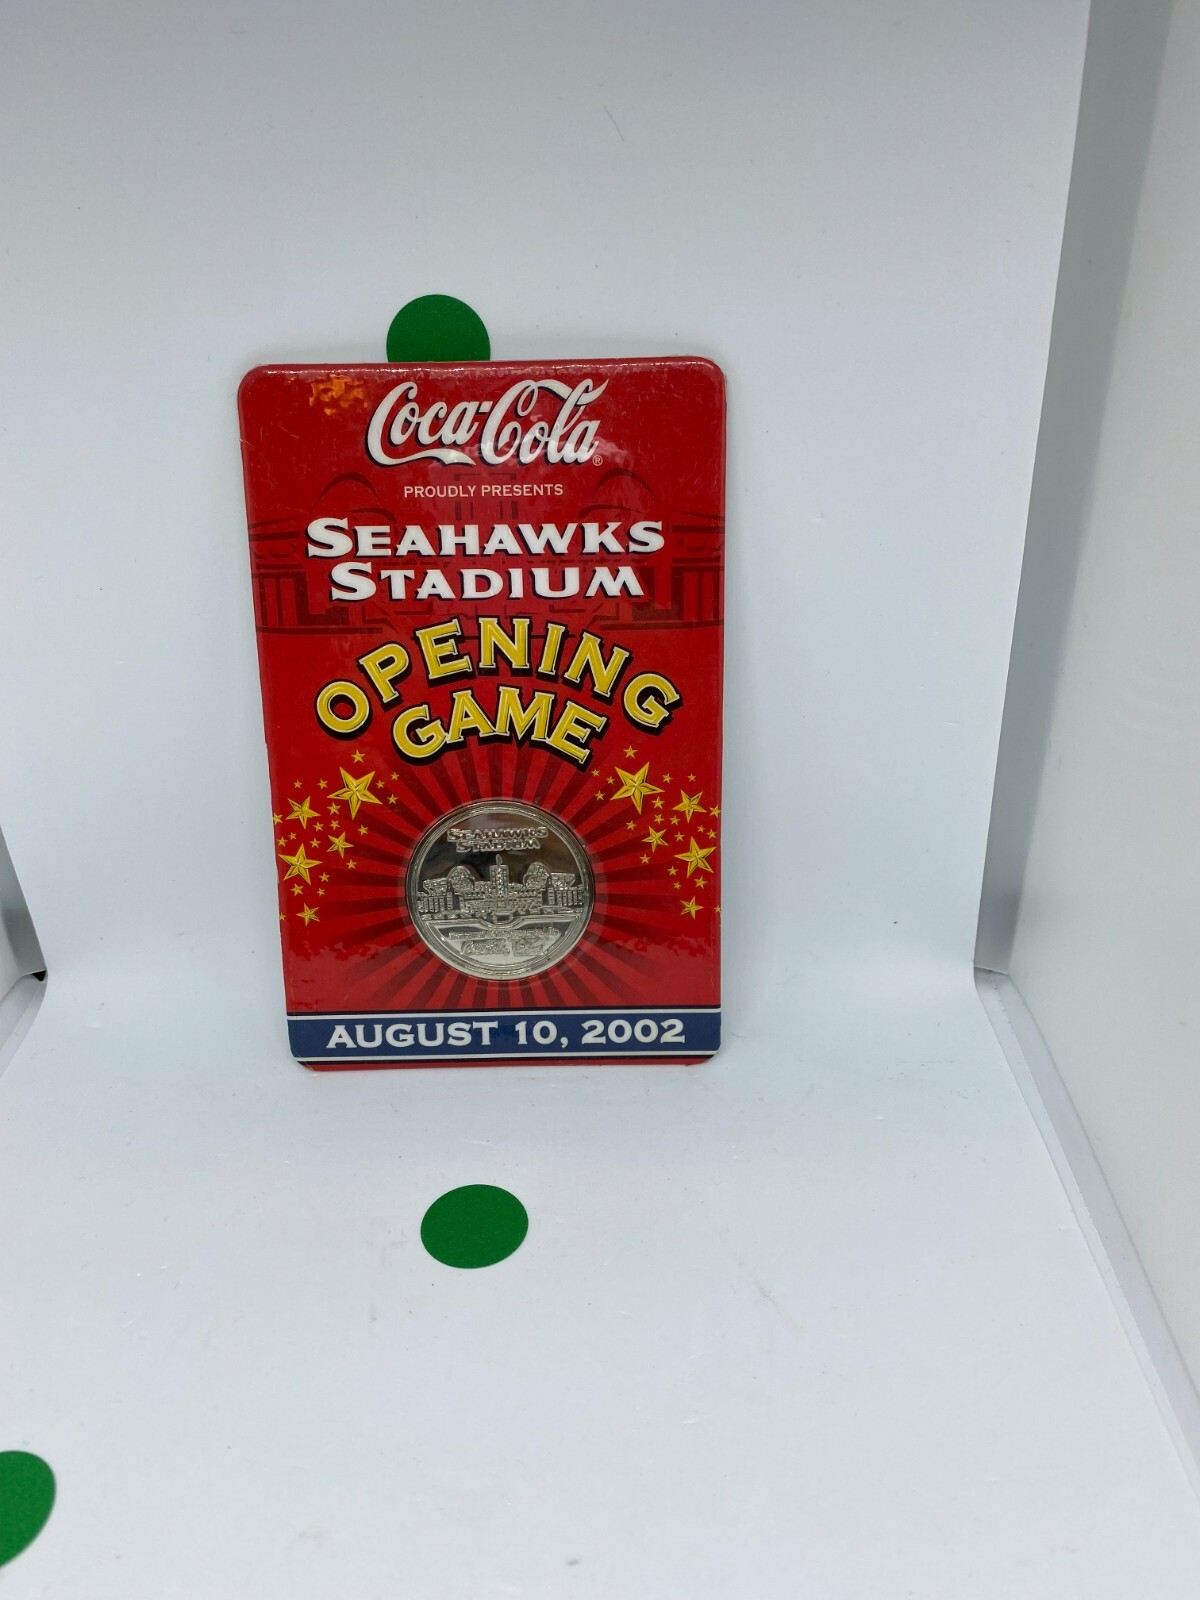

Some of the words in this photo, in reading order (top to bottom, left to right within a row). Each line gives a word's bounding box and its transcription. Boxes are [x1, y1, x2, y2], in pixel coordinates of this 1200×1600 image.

[367, 379, 608, 467] Coca-Cola
[404, 484, 476, 499] PROUDLY
[481, 483, 564, 497] PRESENTS
[307, 517, 665, 558] SEAHAWKS
[331, 561, 644, 601] STADIUM
[316, 617, 682, 734] OPENING
[393, 686, 607, 764] GAME
[326, 1021, 498, 1049] AUGUST
[514, 1020, 568, 1049] 10,
[581, 1019, 686, 1044] 2002
